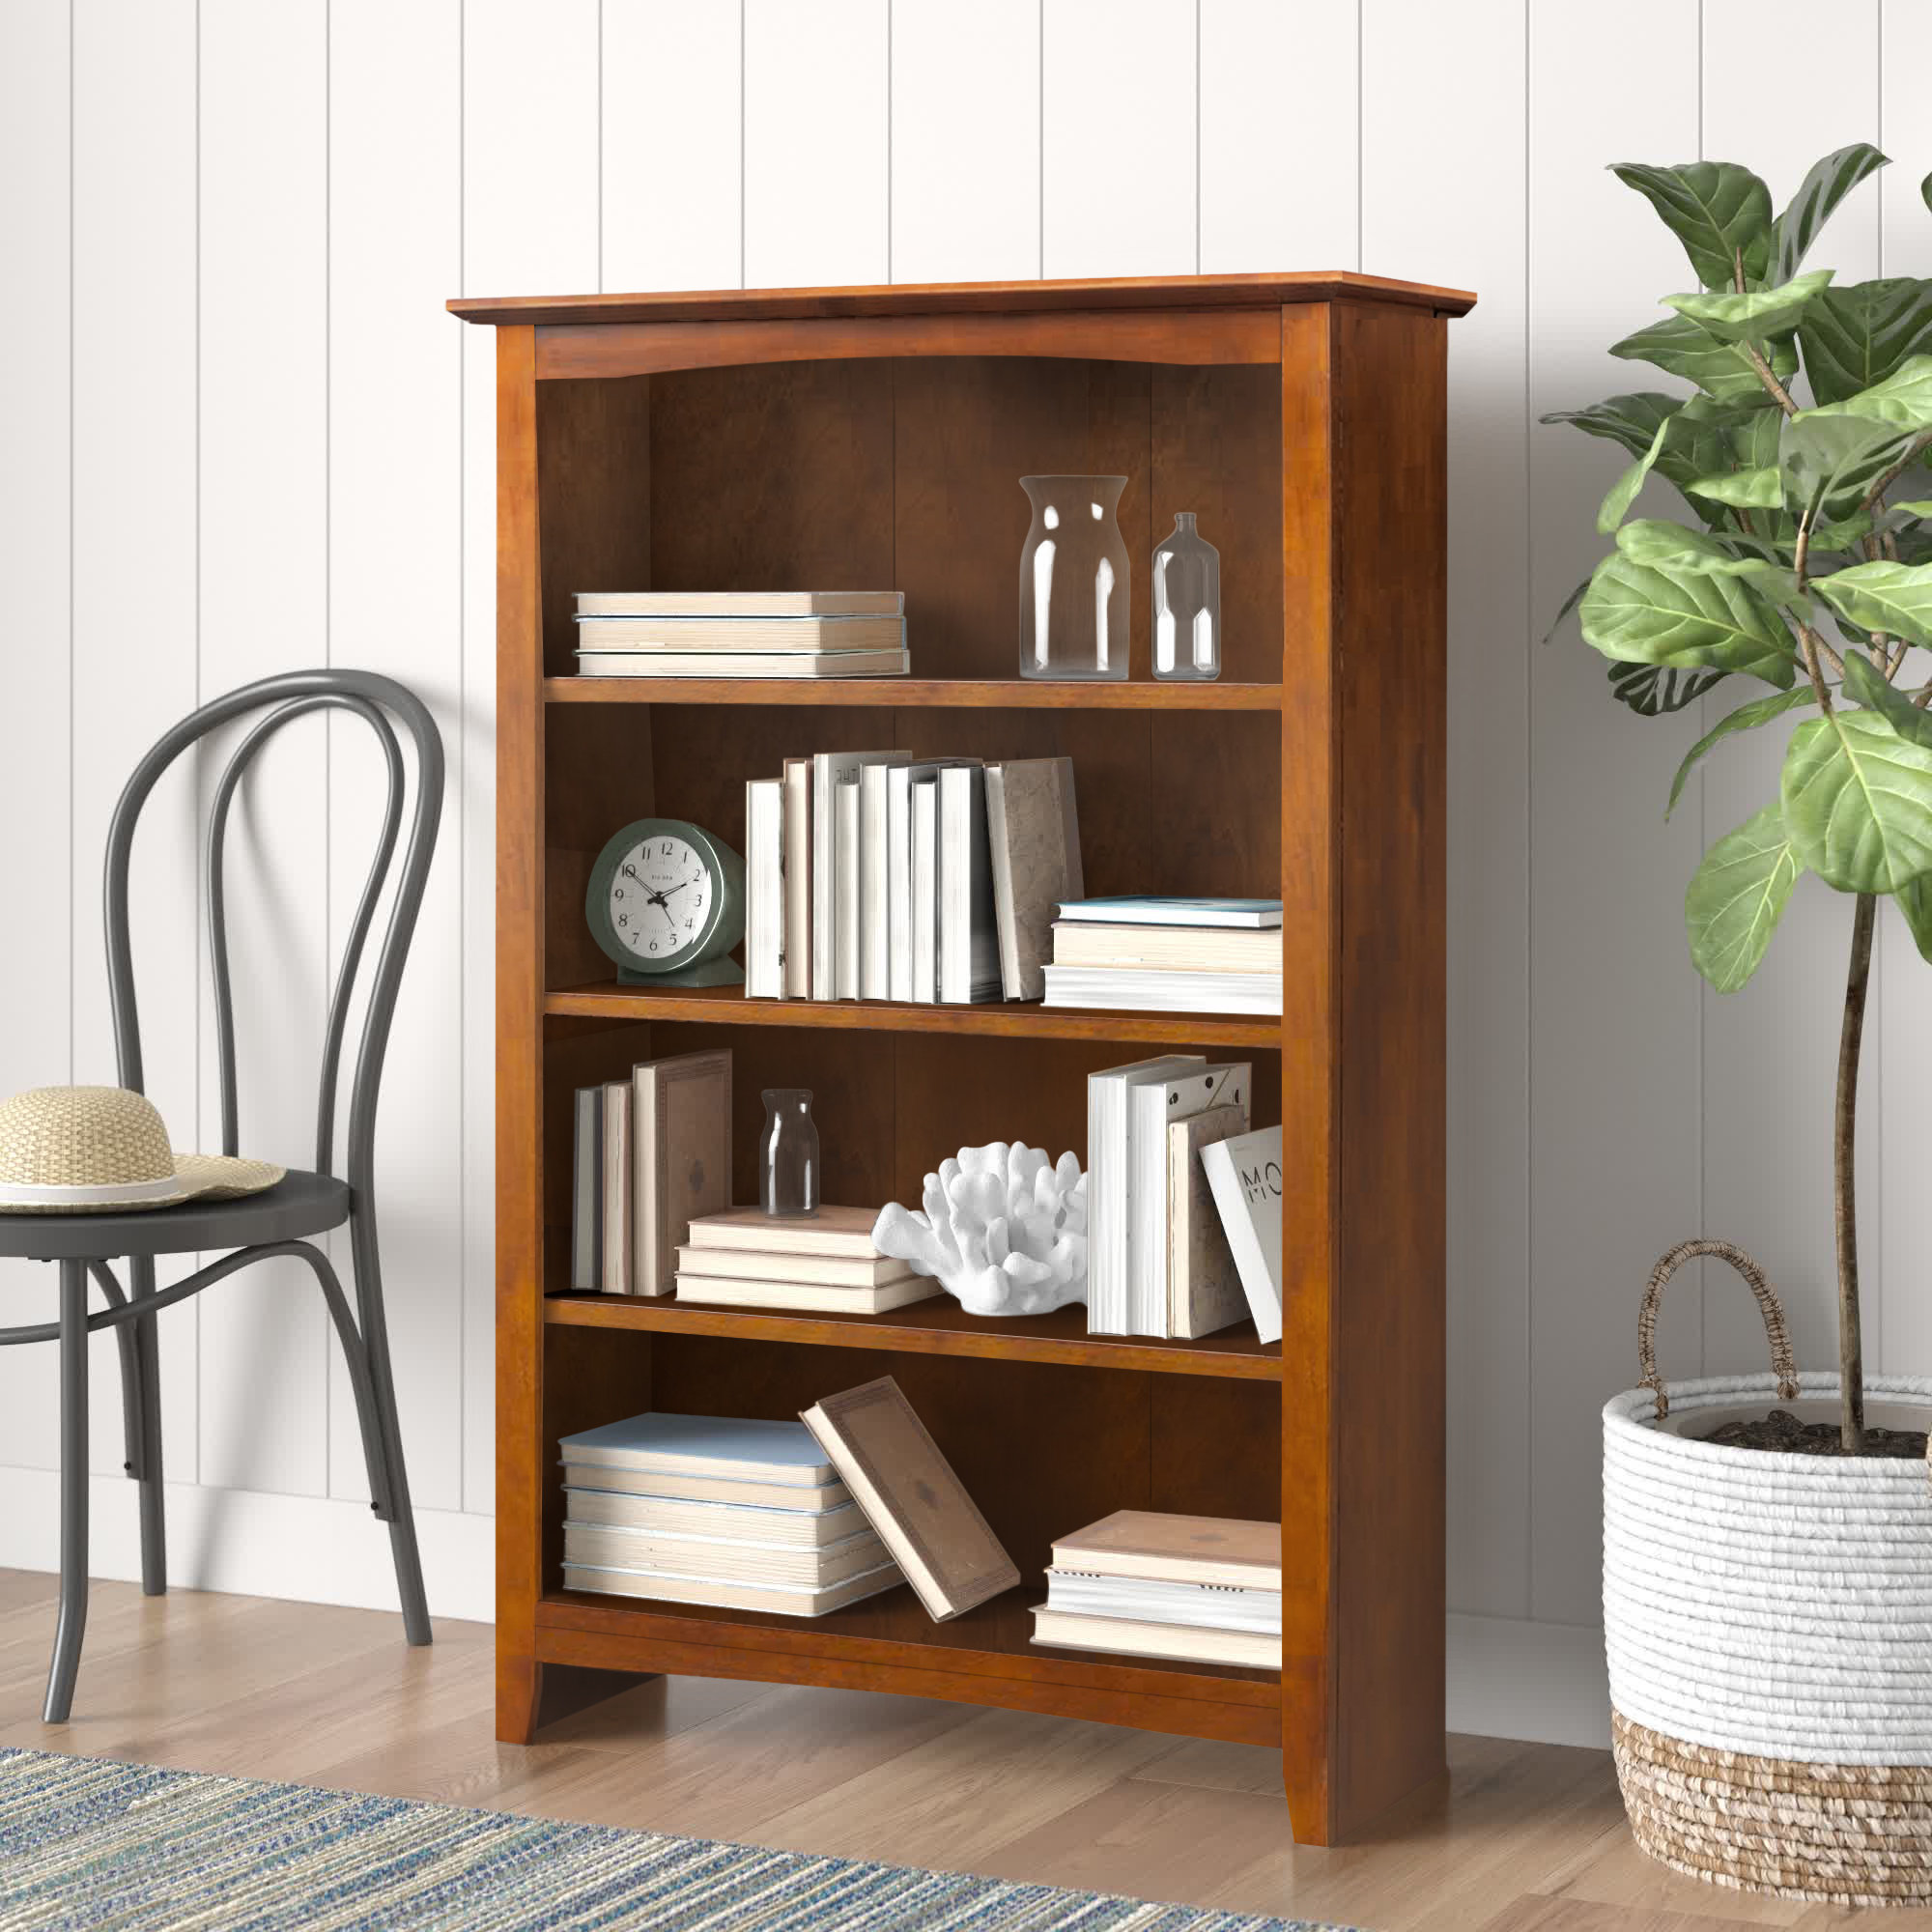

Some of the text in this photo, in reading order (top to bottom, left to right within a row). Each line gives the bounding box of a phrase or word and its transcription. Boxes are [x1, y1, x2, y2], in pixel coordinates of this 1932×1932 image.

[641, 846, 651, 860] 11
[661, 841, 673, 855] 12
[683, 851, 688, 864] 1
[621, 864, 637, 878] 10
[694, 868, 700, 881] 2
[614, 889, 624, 901] 9
[695, 894, 702, 907] 3
[618, 913, 628, 927] 8
[684, 917, 694, 929] 4
[632, 932, 639, 945] 7
[649, 937, 658, 952] 6
[668, 933, 677, 946] 5
